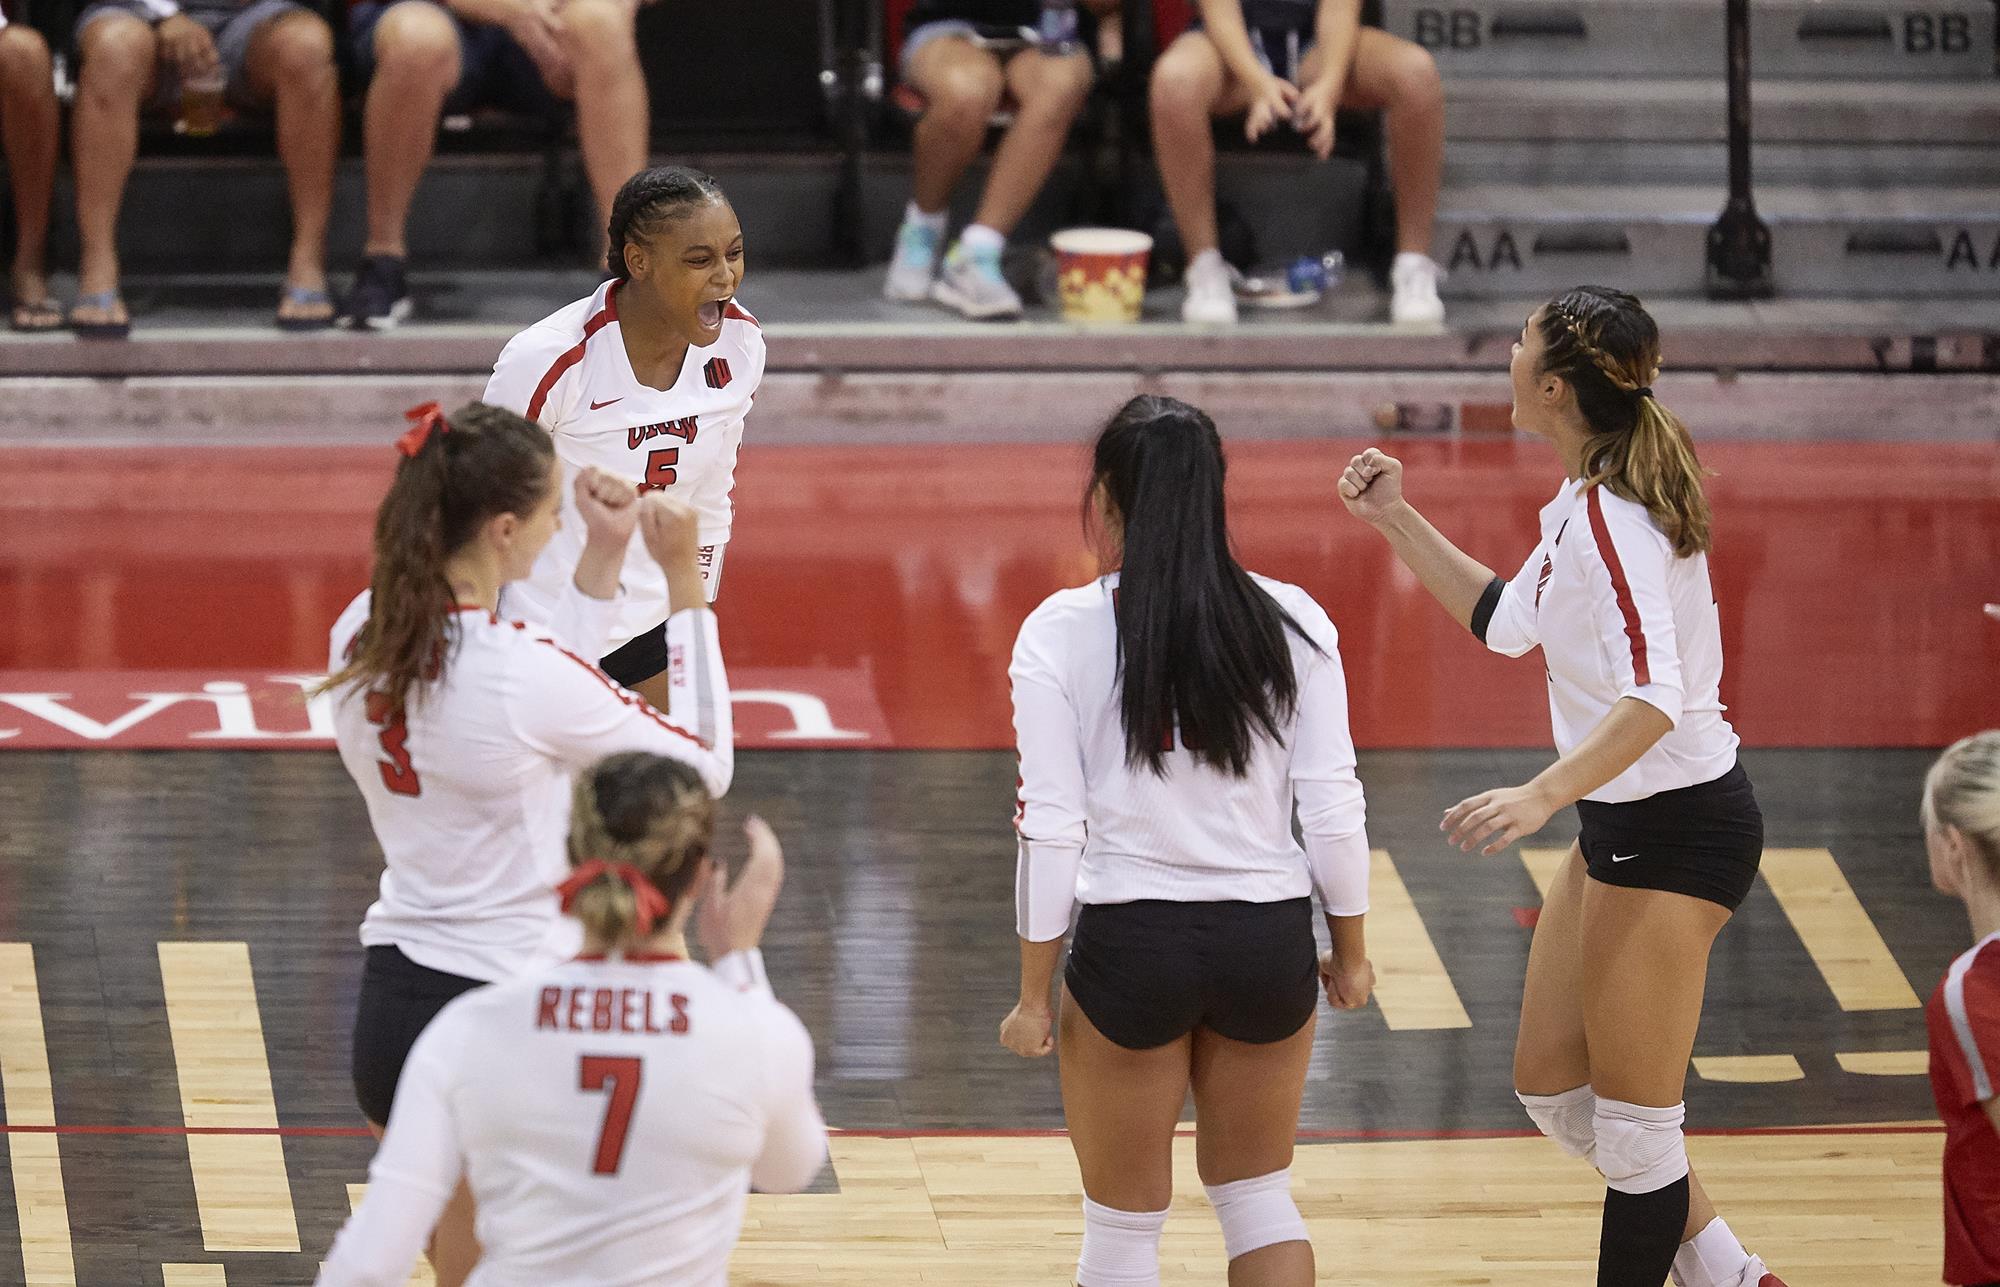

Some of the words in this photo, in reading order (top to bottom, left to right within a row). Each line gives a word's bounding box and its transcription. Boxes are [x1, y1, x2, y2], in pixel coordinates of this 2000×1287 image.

[1415, 9, 1481, 50] BB
[1904, 11, 1971, 52] BB
[1449, 229, 1522, 272] AA
[637, 447, 680, 494] 5
[364, 690, 421, 797] 3
[537, 985, 690, 1035] REBELS
[578, 1054, 644, 1176] 7
